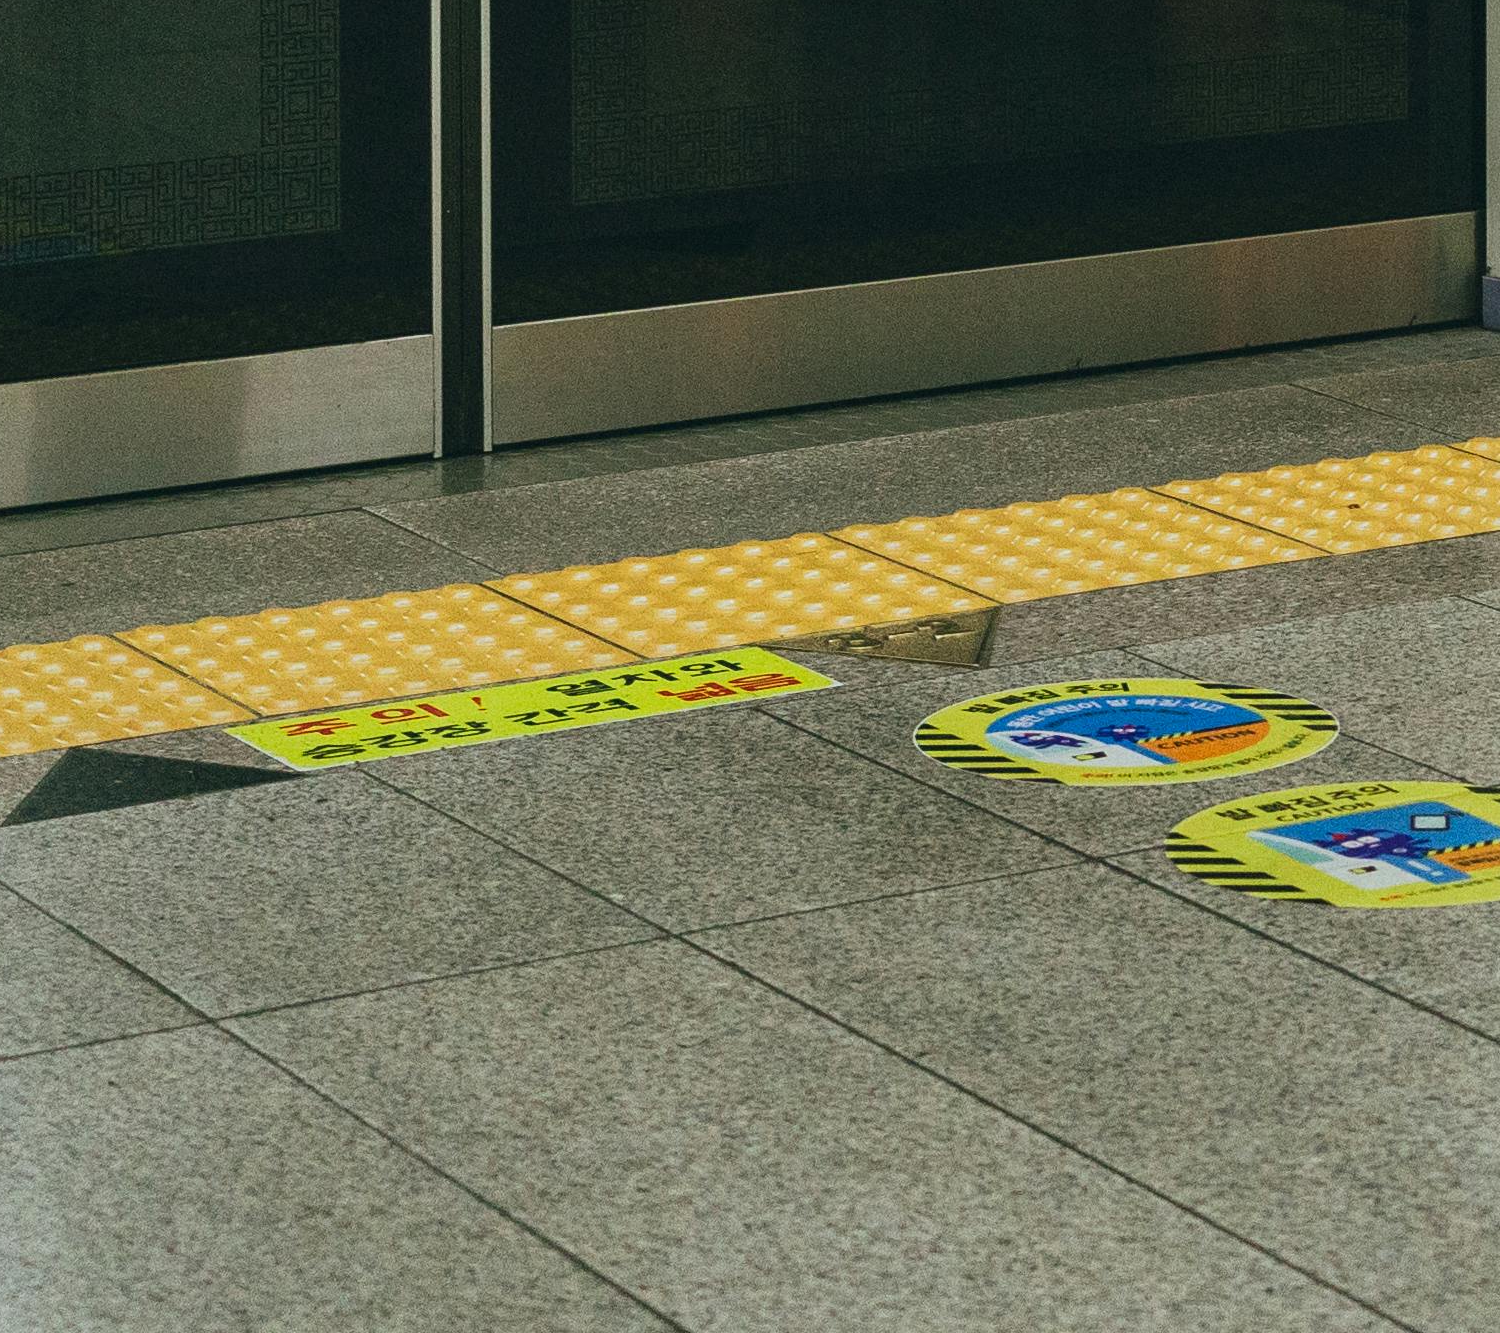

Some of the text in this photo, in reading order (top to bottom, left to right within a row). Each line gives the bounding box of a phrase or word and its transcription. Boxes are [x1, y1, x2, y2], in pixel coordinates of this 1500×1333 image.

[544, 658, 747, 698] 열차와
[1066, 682, 1130, 694] 주의
[301, 719, 493, 763] 승강장
[506, 695, 640, 728] 간격
[1158, 729, 1256, 750] CAUTION
[1332, 783, 1401, 802] 주의
[1275, 801, 1374, 824] CAUTION
